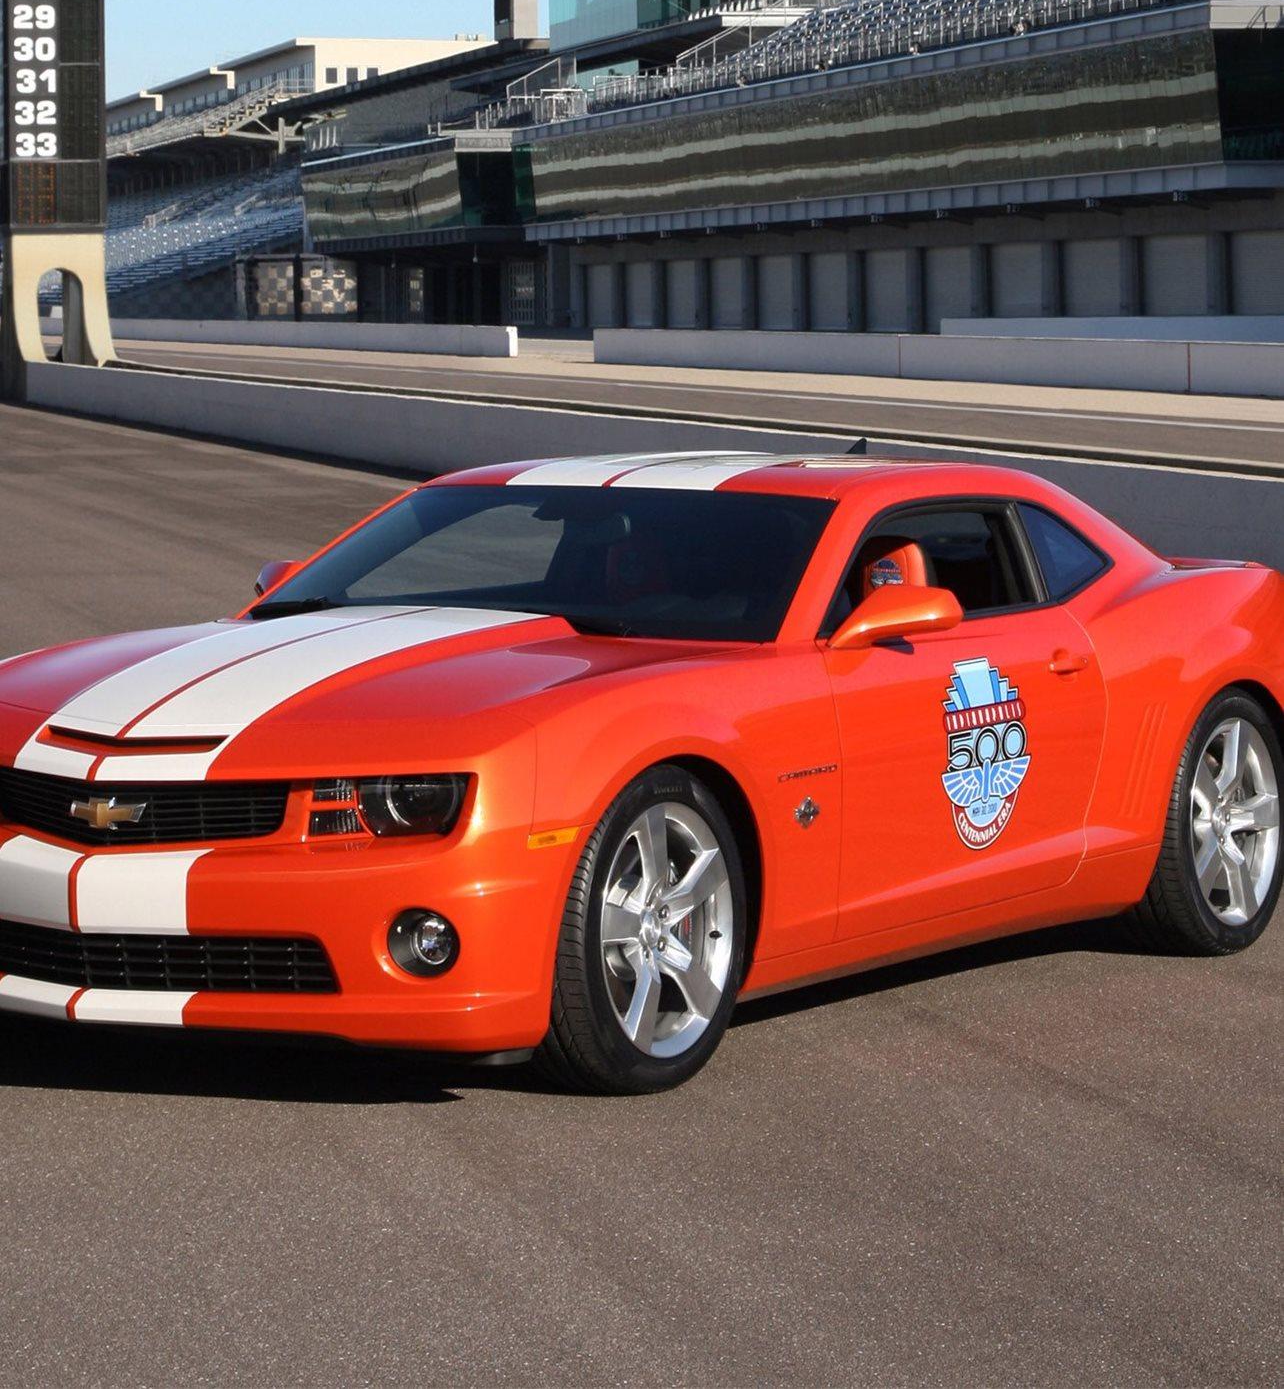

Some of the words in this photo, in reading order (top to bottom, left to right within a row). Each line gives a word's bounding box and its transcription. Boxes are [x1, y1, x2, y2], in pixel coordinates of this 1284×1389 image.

[12, 4, 55, 29] 29
[13, 36, 56, 61] 30
[15, 68, 56, 93] 31
[14, 99, 56, 125] 32
[15, 131, 57, 157] 33
[946, 702, 1021, 730] INDIANAPOLIS
[948, 721, 1027, 772] 500
[958, 812, 998, 842] CENTENNIAL
[997, 802, 1011, 827] ERA
